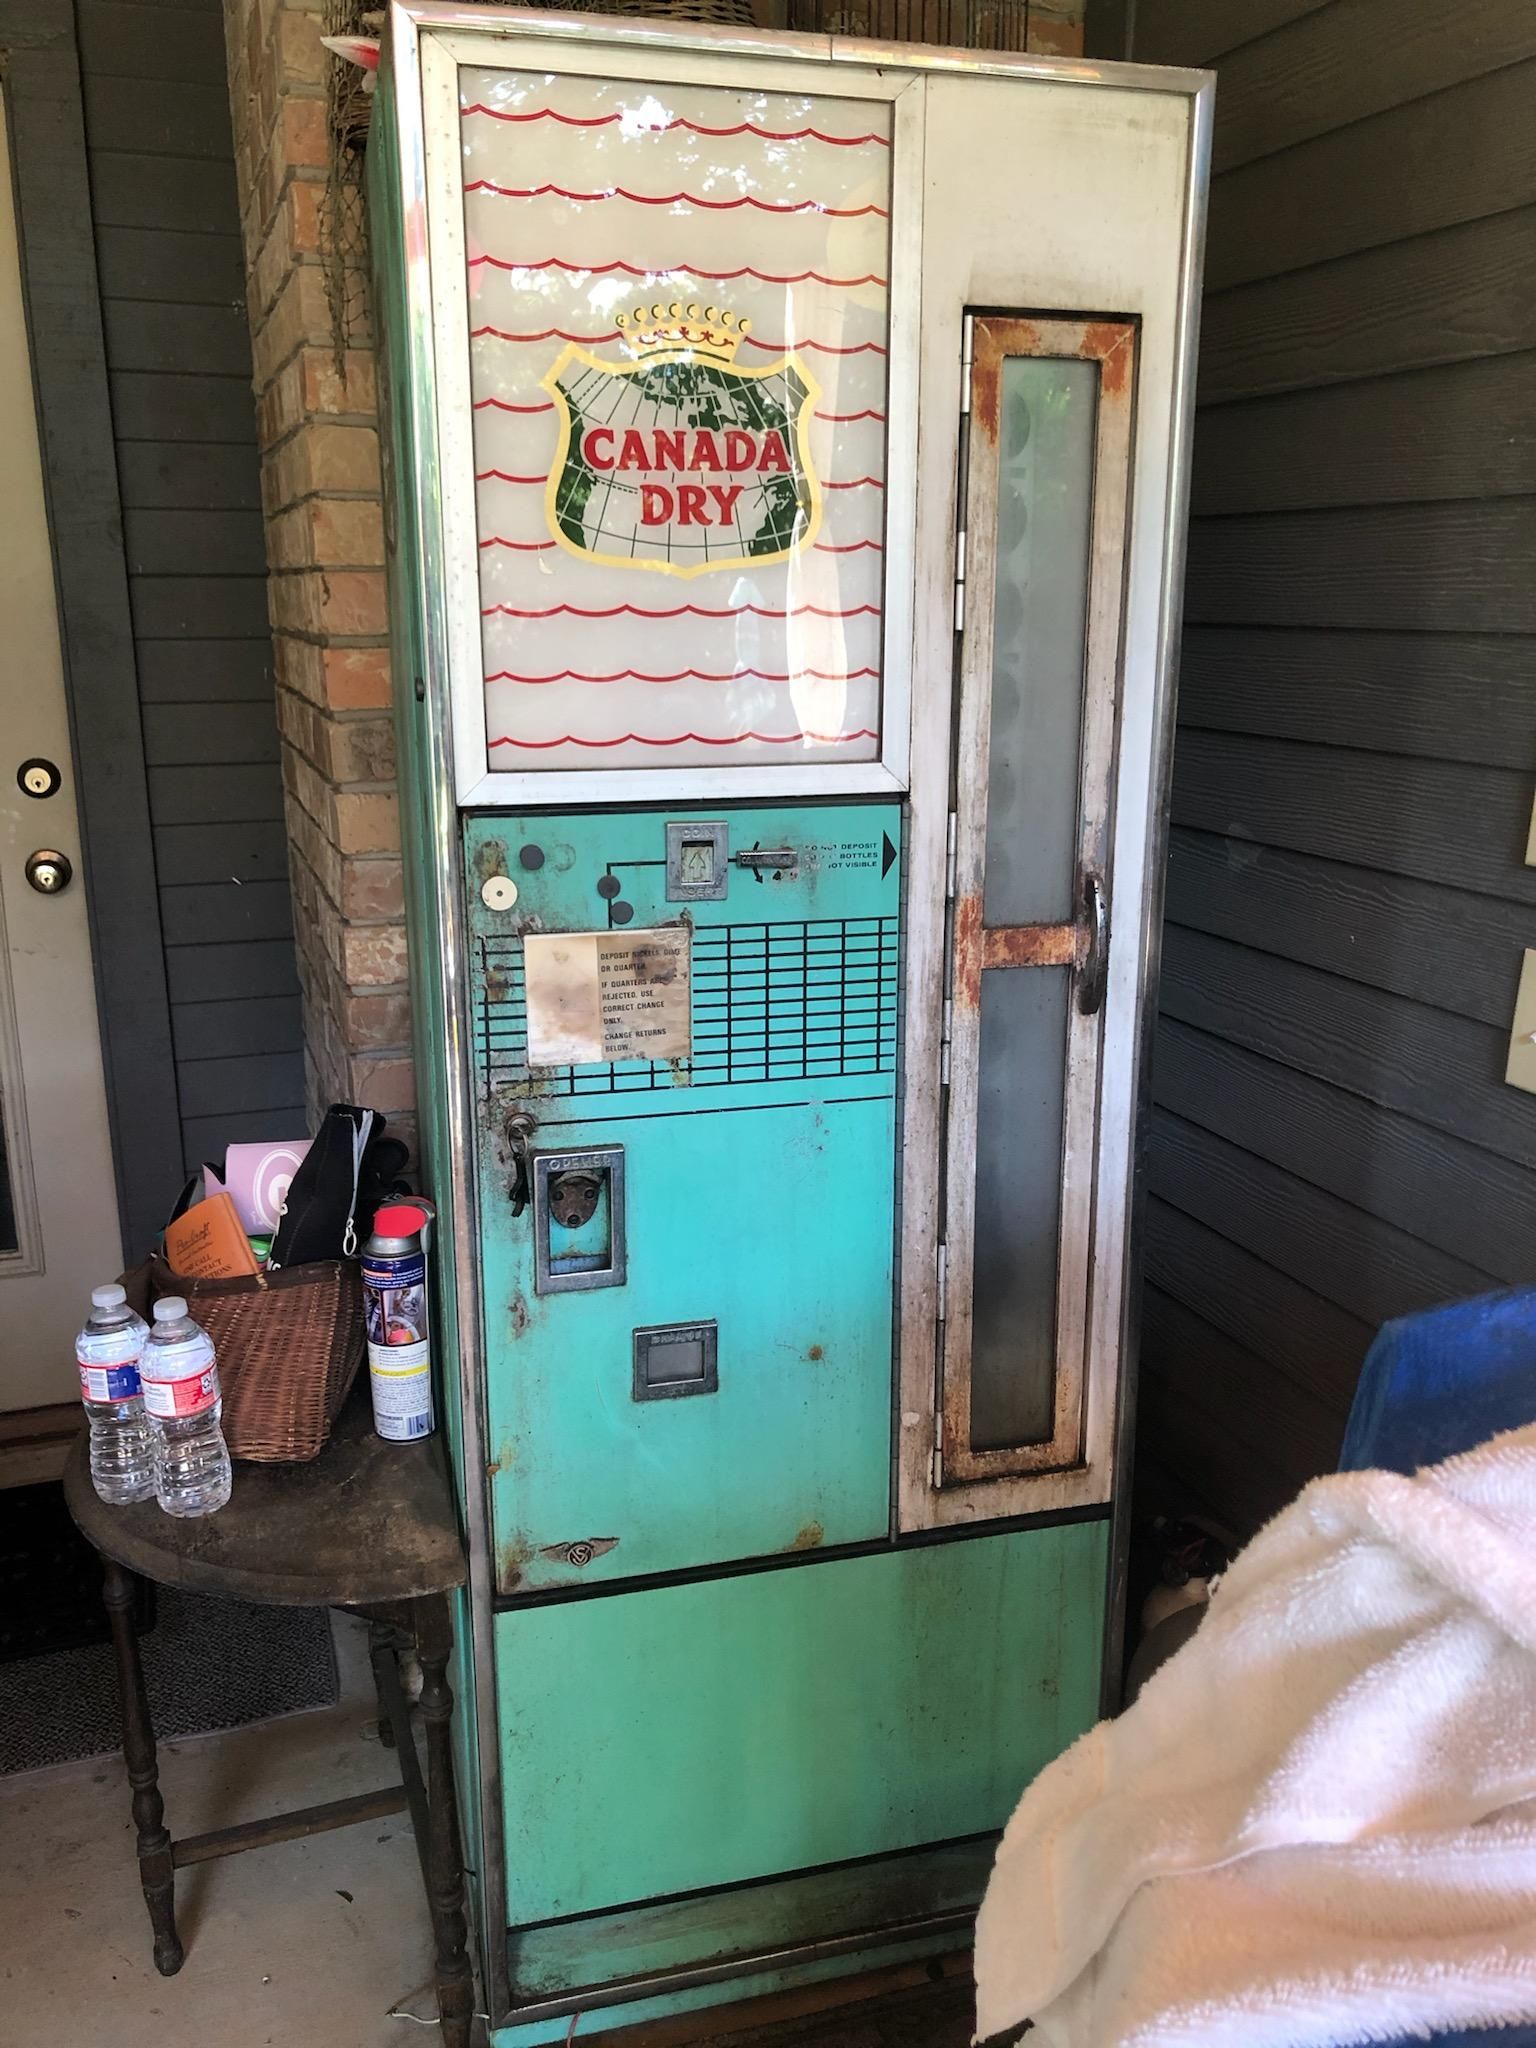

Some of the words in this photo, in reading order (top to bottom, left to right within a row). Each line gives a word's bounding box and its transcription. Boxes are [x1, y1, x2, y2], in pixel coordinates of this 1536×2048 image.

[584, 428, 792, 472] CANADA
[640, 484, 745, 526] DRY
[841, 842, 878, 850] DEPOSIT
[600, 951, 629, 961] DEPOSIT
[600, 965, 611, 973] OR
[601, 981, 607, 989] IF
[611, 979, 648, 988] QUARTERS
[640, 990, 653, 998] USE
[602, 1004, 634, 1013] CORRECT
[637, 1001, 665, 1010] CHANGE
[604, 1031, 632, 1040] CHANGE
[635, 1028, 667, 1038] RETURNS
